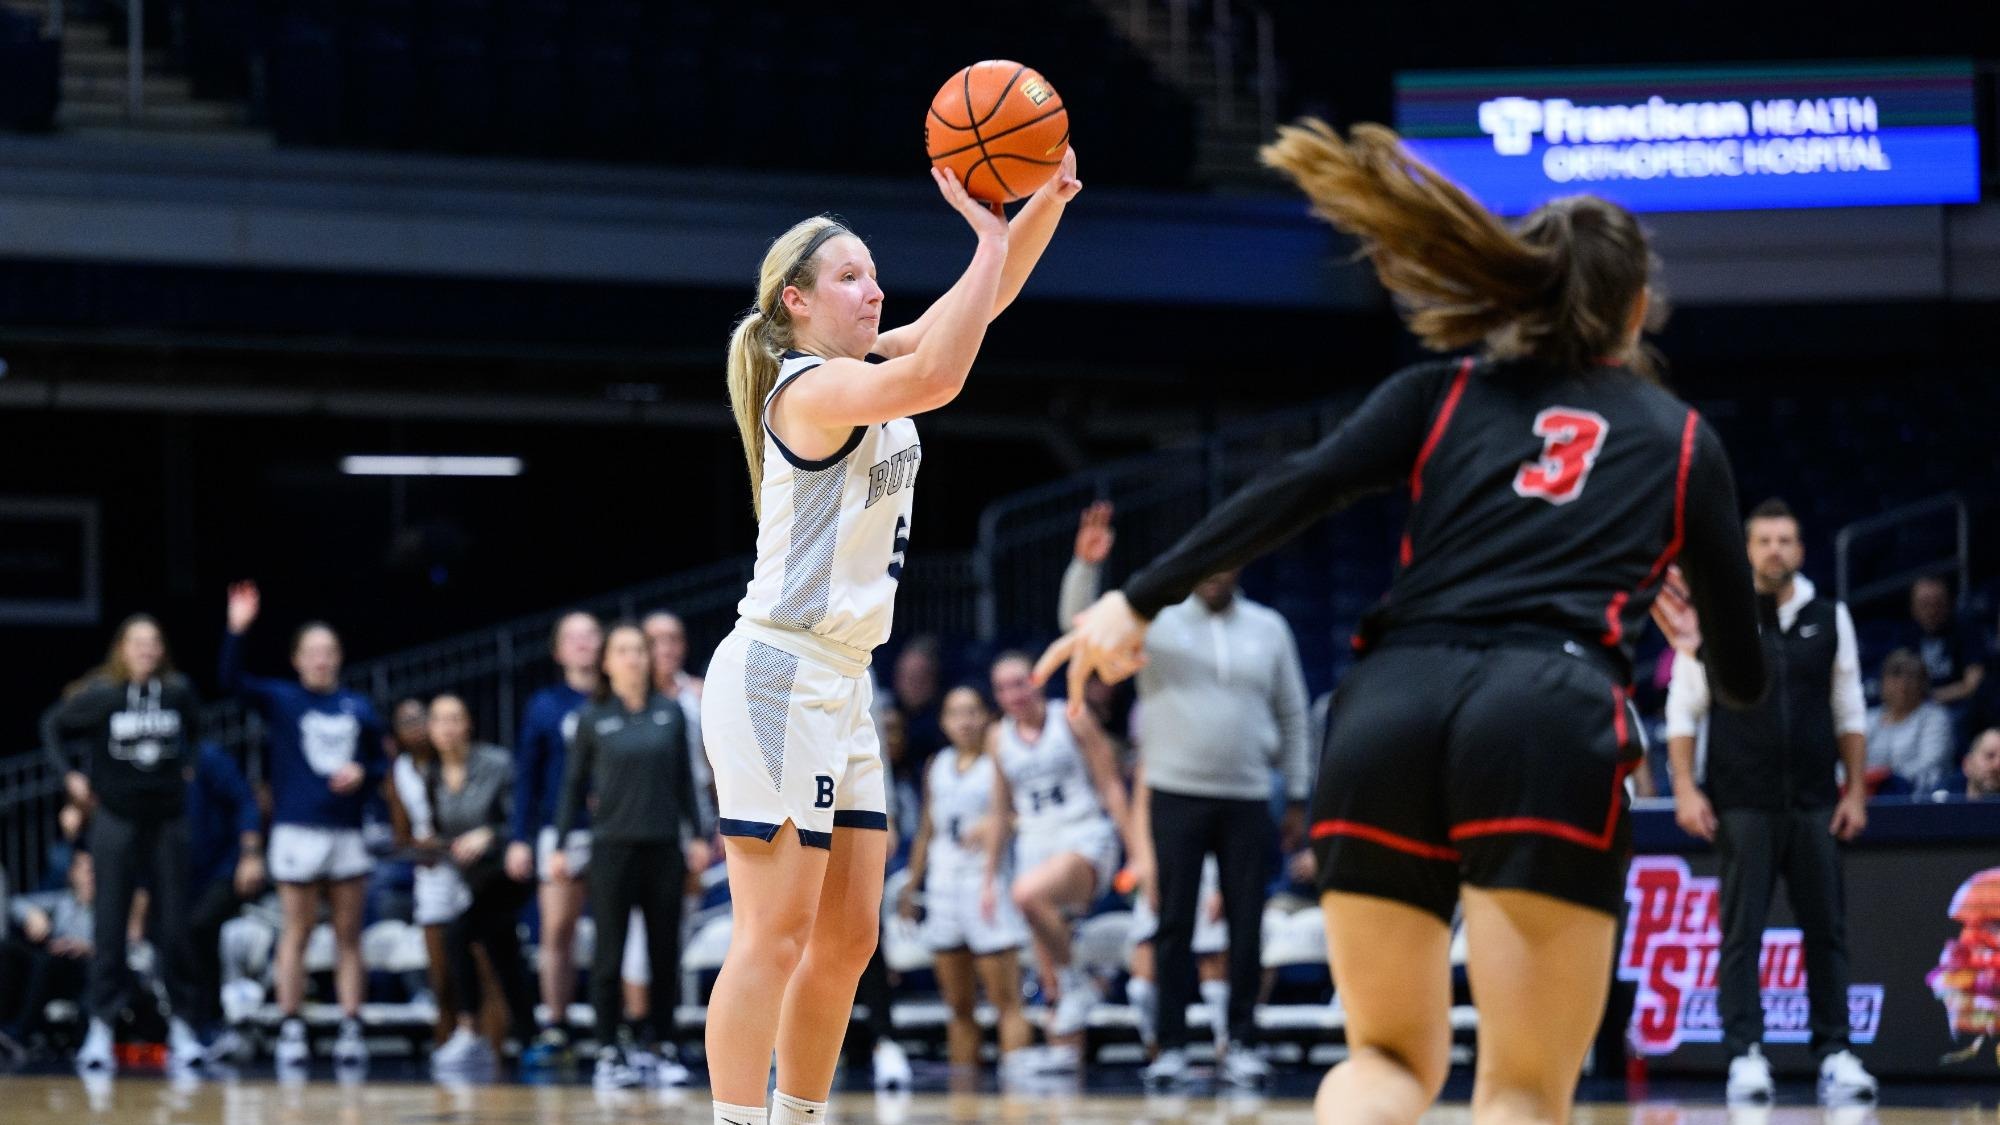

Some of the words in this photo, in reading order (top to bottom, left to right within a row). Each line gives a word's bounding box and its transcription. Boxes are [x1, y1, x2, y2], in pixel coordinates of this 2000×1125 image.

[1752, 97, 1878, 136] HEALTH
[1743, 135, 1891, 175] HOSPITAL
[865, 444, 921, 509] BUT
[1513, 406, 1609, 506] 3
[814, 775, 835, 809] B
[1628, 864, 1721, 970] PEN
[1638, 942, 1806, 1045] STIO
